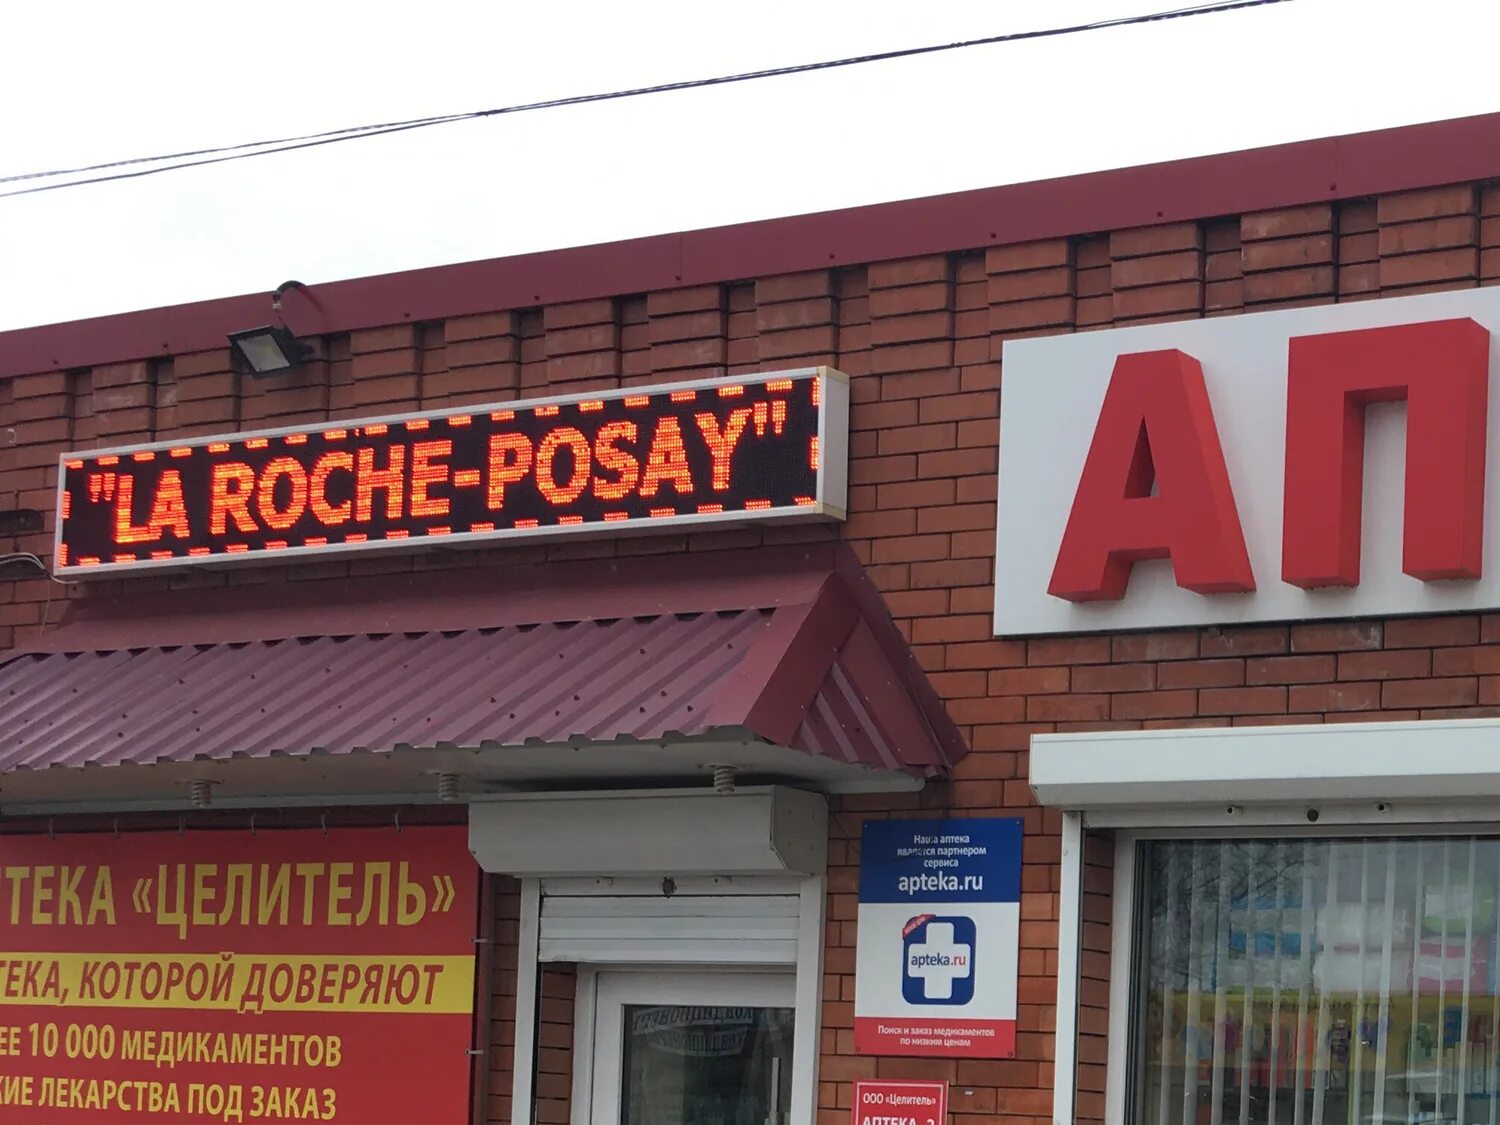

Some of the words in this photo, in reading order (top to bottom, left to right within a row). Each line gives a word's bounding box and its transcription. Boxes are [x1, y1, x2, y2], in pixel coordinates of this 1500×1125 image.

[89, 471, 190, 544] "LA
[209, 400, 786, 536] ROCHE-POSAY"
[939, 835, 970, 845] аптека
[937, 847, 987, 858] партнером
[924, 858, 959, 868] сервиса
[898, 871, 984, 895] apteka.ru
[0, 864, 116, 925] ТЕКА
[132, 861, 456, 939] «ЦЕЛИТЕЛЬ»
[911, 953, 966, 968] apteka.ru
[79, 954, 234, 1003] КОТОРОЙ
[238, 963, 445, 1013] ДОВЕРЯЮТ
[878, 1025, 902, 1035] Поиск
[910, 1027, 932, 1036] заказ
[933, 1027, 995, 1039] медикаментов
[29, 1023, 59, 1058] 10
[65, 1025, 115, 1060] 000
[121, 1031, 342, 1068] МЕДИКАМЕНТОВ
[912, 1038, 943, 1047] низким
[944, 1039, 971, 1048] ценам
[38, 1077, 180, 1113] ЛЕКАРСТВА
[188, 1084, 243, 1123] ПОД
[251, 1086, 336, 1120] ЗАКАЗ
[863, 1093, 883, 1104] ООО
[885, 1093, 936, 1106] «Целитель»
